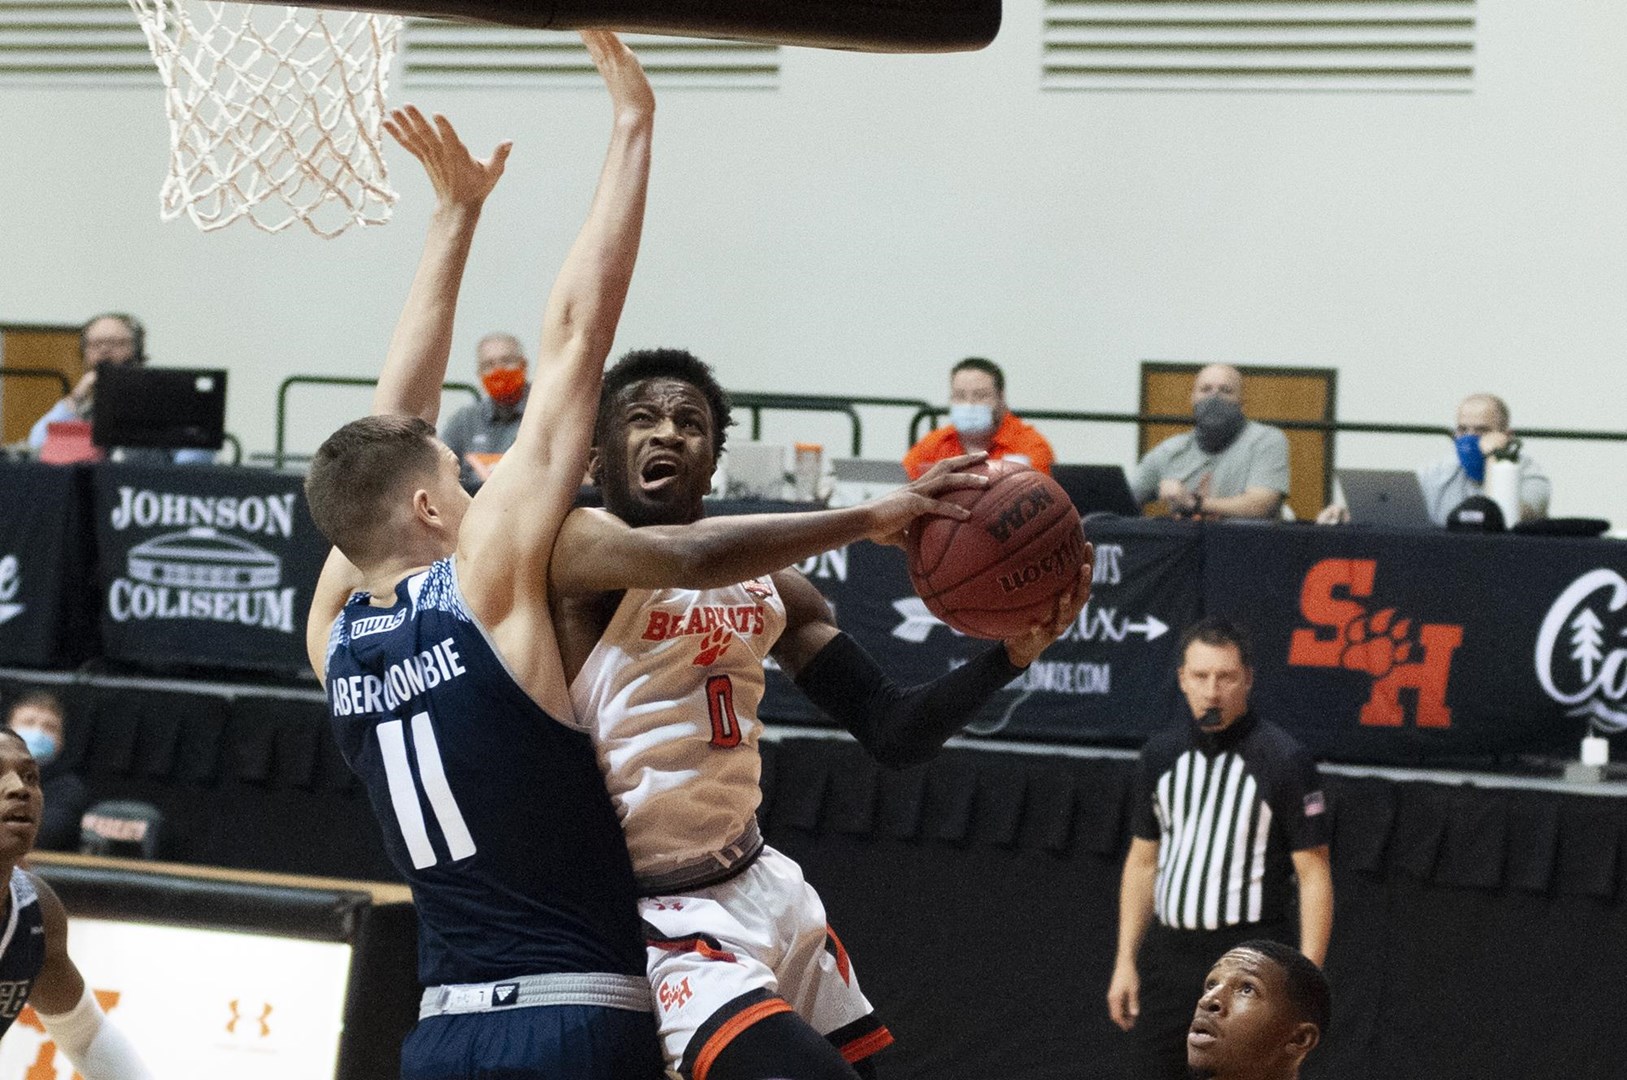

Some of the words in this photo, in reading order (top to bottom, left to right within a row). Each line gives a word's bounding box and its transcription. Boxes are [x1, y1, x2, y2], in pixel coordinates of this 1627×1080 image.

[111, 486, 296, 538] JOHNSON
[985, 485, 1055, 543] NCAA
[109, 577, 296, 633] COLISEUM
[352, 608, 407, 640] OWLS
[705, 674, 742, 749] 0
[376, 711, 477, 870] 11
